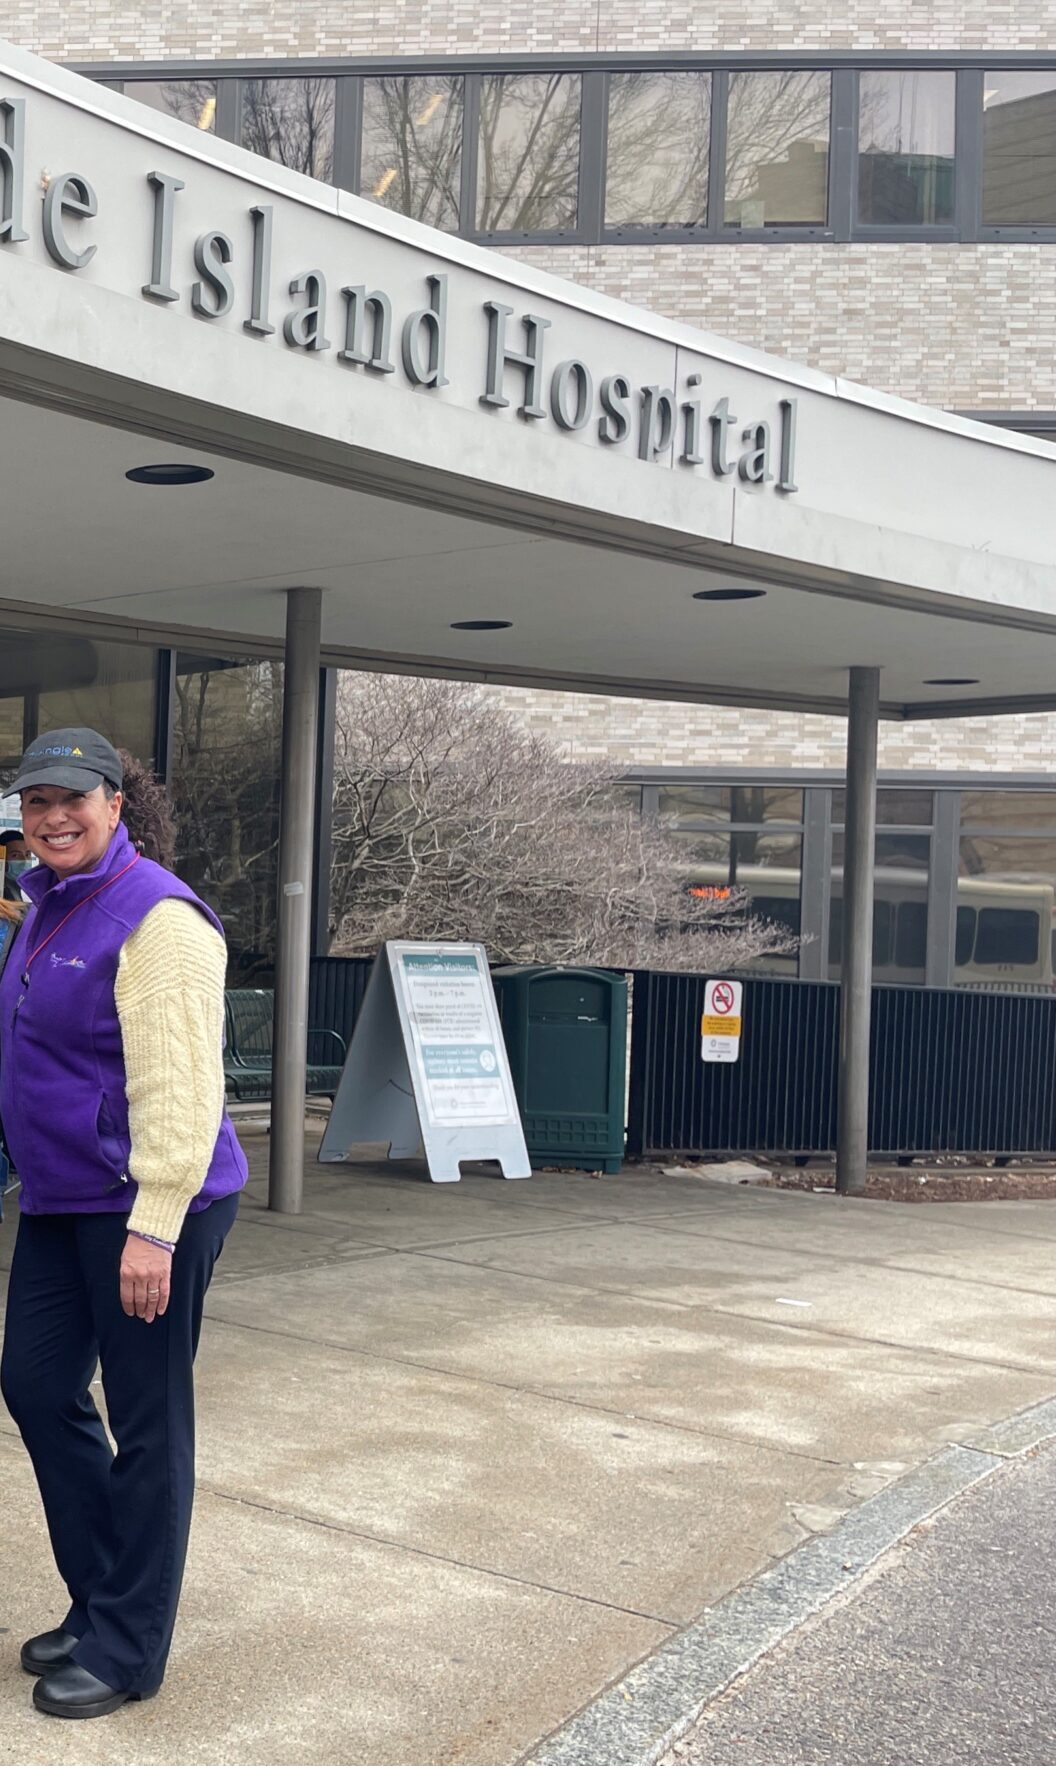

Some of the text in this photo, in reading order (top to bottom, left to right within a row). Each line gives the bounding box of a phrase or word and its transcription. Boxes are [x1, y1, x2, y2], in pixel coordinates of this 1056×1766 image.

[142, 170, 449, 387] Island
[479, 301, 798, 492] Hospital
[408, 962, 442, 972] Attention
